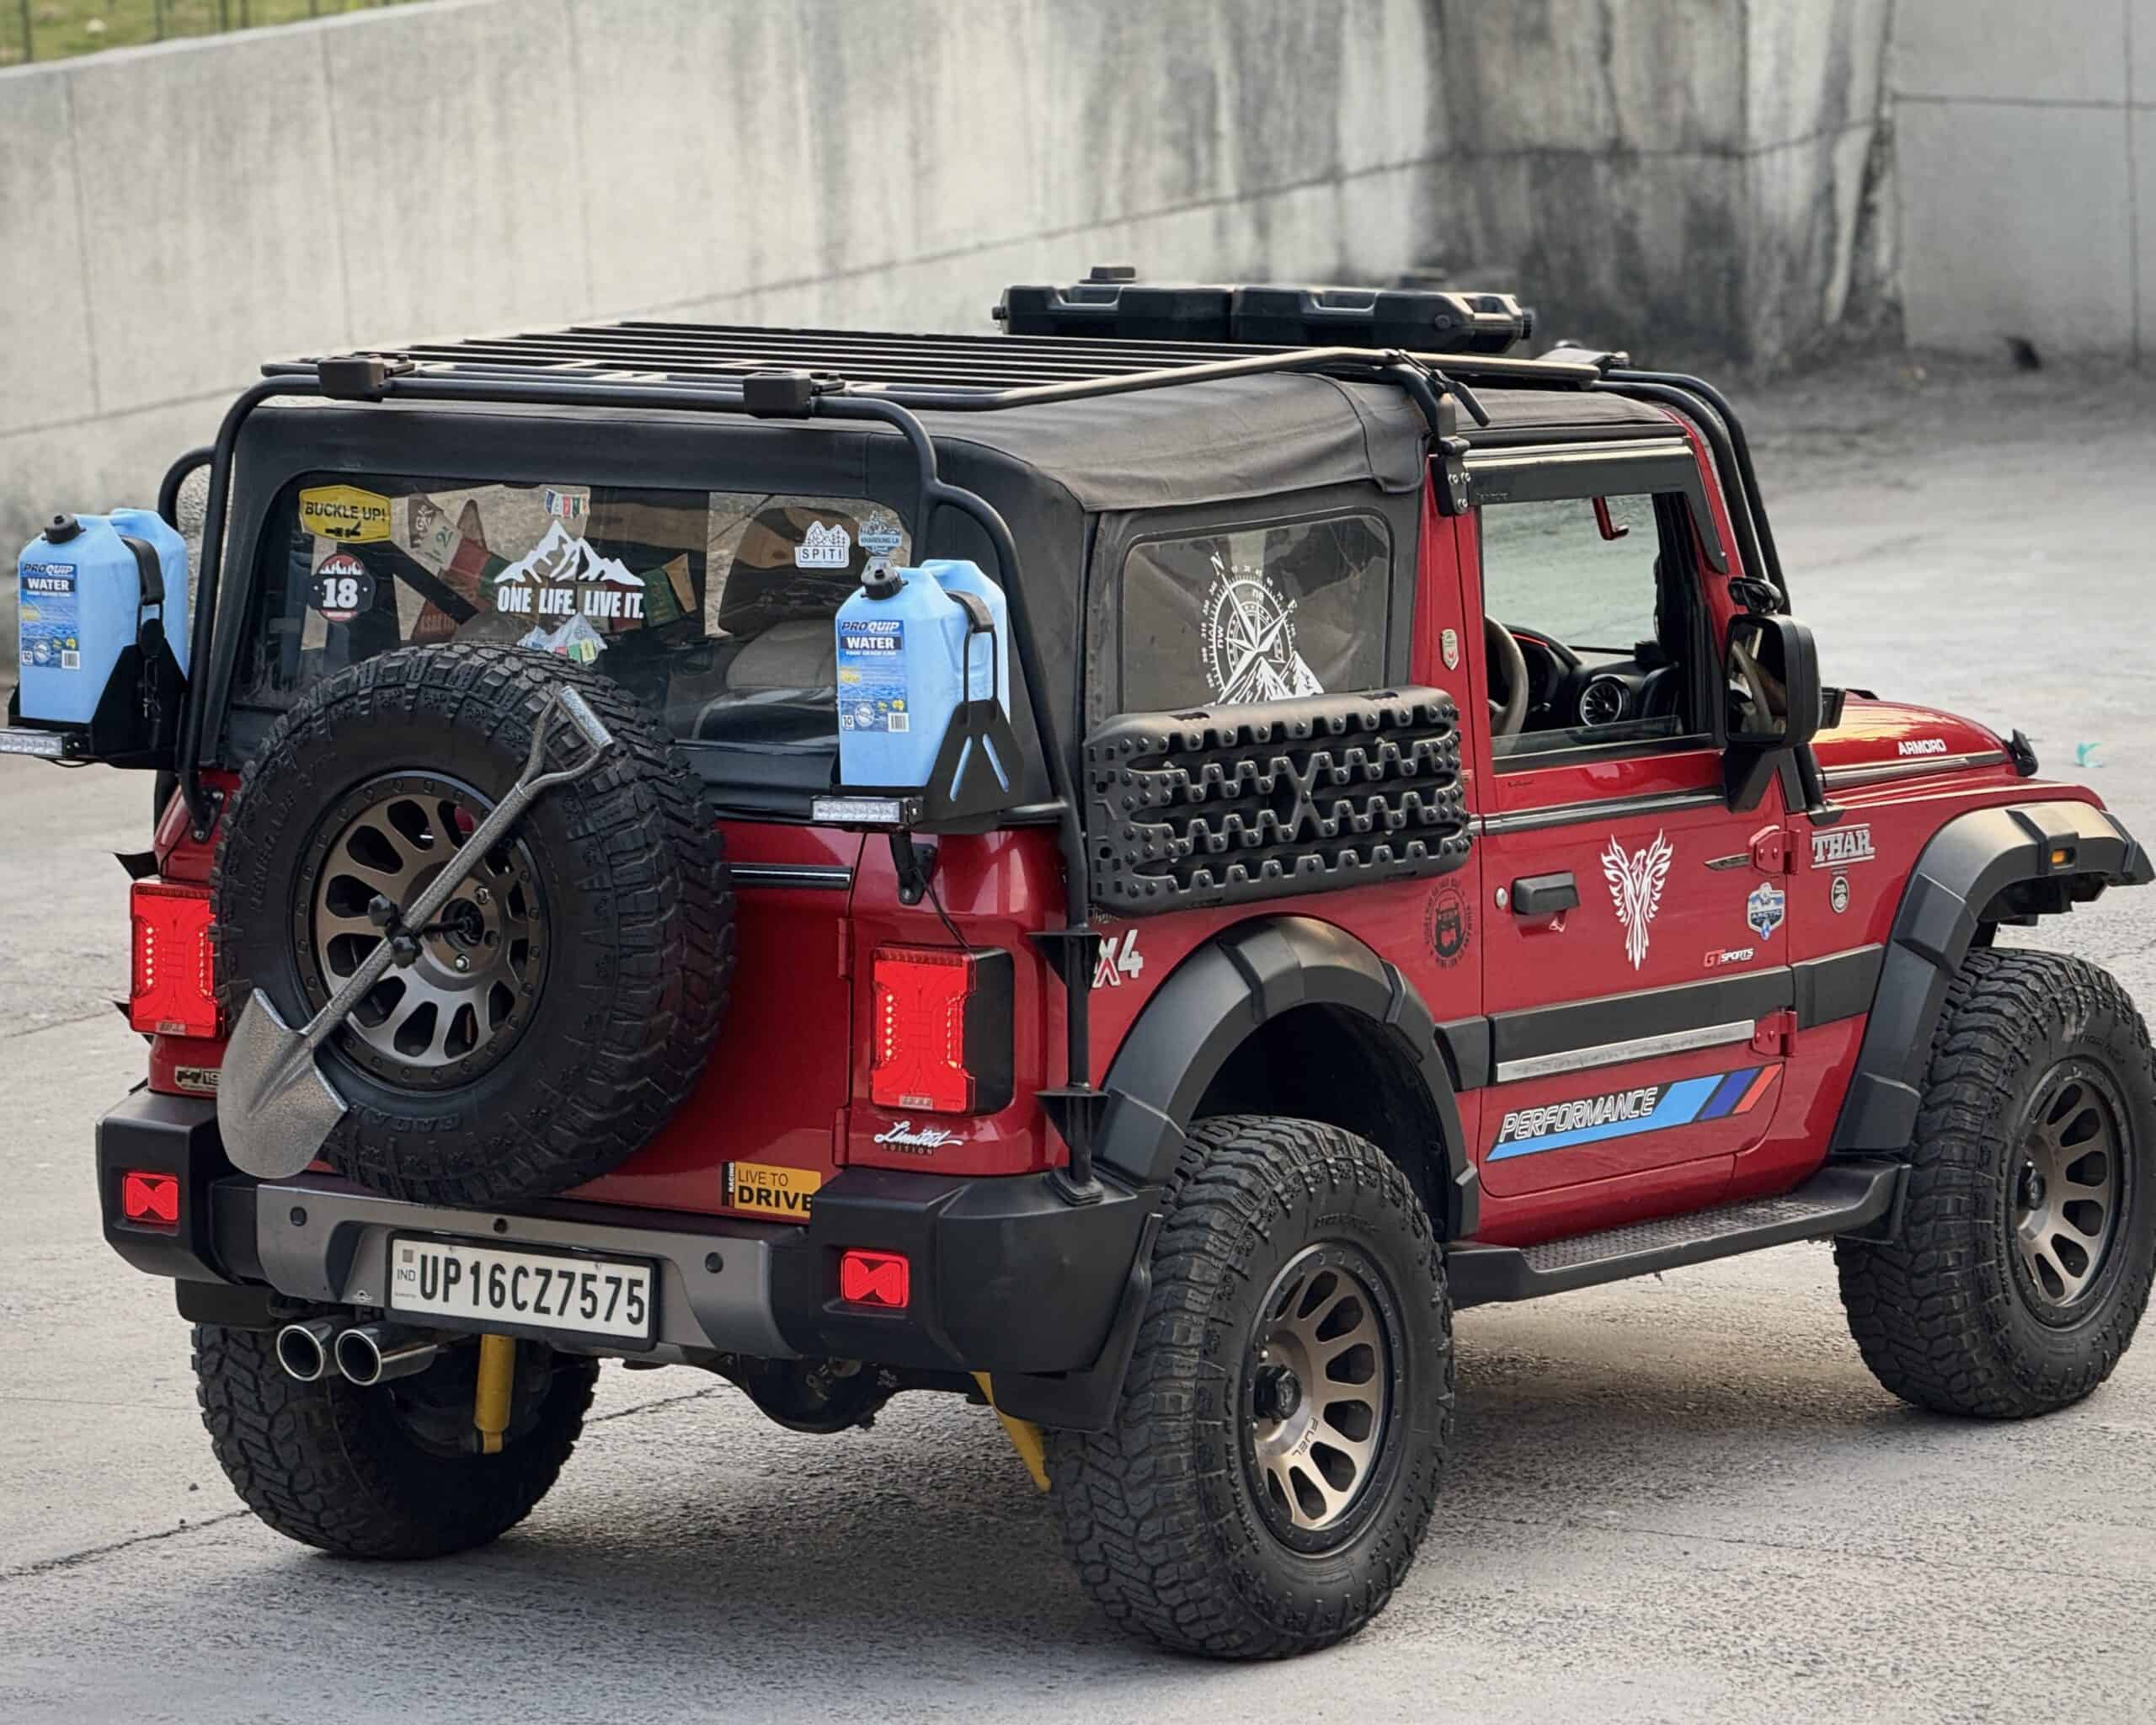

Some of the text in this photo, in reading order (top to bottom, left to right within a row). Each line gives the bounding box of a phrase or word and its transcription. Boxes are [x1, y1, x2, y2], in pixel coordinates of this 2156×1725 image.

[305, 501, 386, 522] BUCKLE UP!
[802, 548, 842, 560] SPITI
[24, 563, 75, 578] PROQUIP
[27, 577, 70, 591] WATER
[322, 577, 359, 609] 18
[497, 585, 533, 613] ONE
[538, 588, 576, 616] LIFE.
[583, 590, 622, 617] LIVE
[841, 621, 900, 634] PROQUIP
[846, 636, 895, 650] WATER
[1812, 829, 1876, 863] THAR
[1092, 929, 1144, 988] X4
[1498, 1087, 1658, 1144] PERFORMANCE
[738, 1168, 789, 1188] LIVE TO
[738, 1185, 813, 1212] DRIVE
[397, 1268, 416, 1282] IND
[420, 1253, 645, 1326] UP16CZ7575
